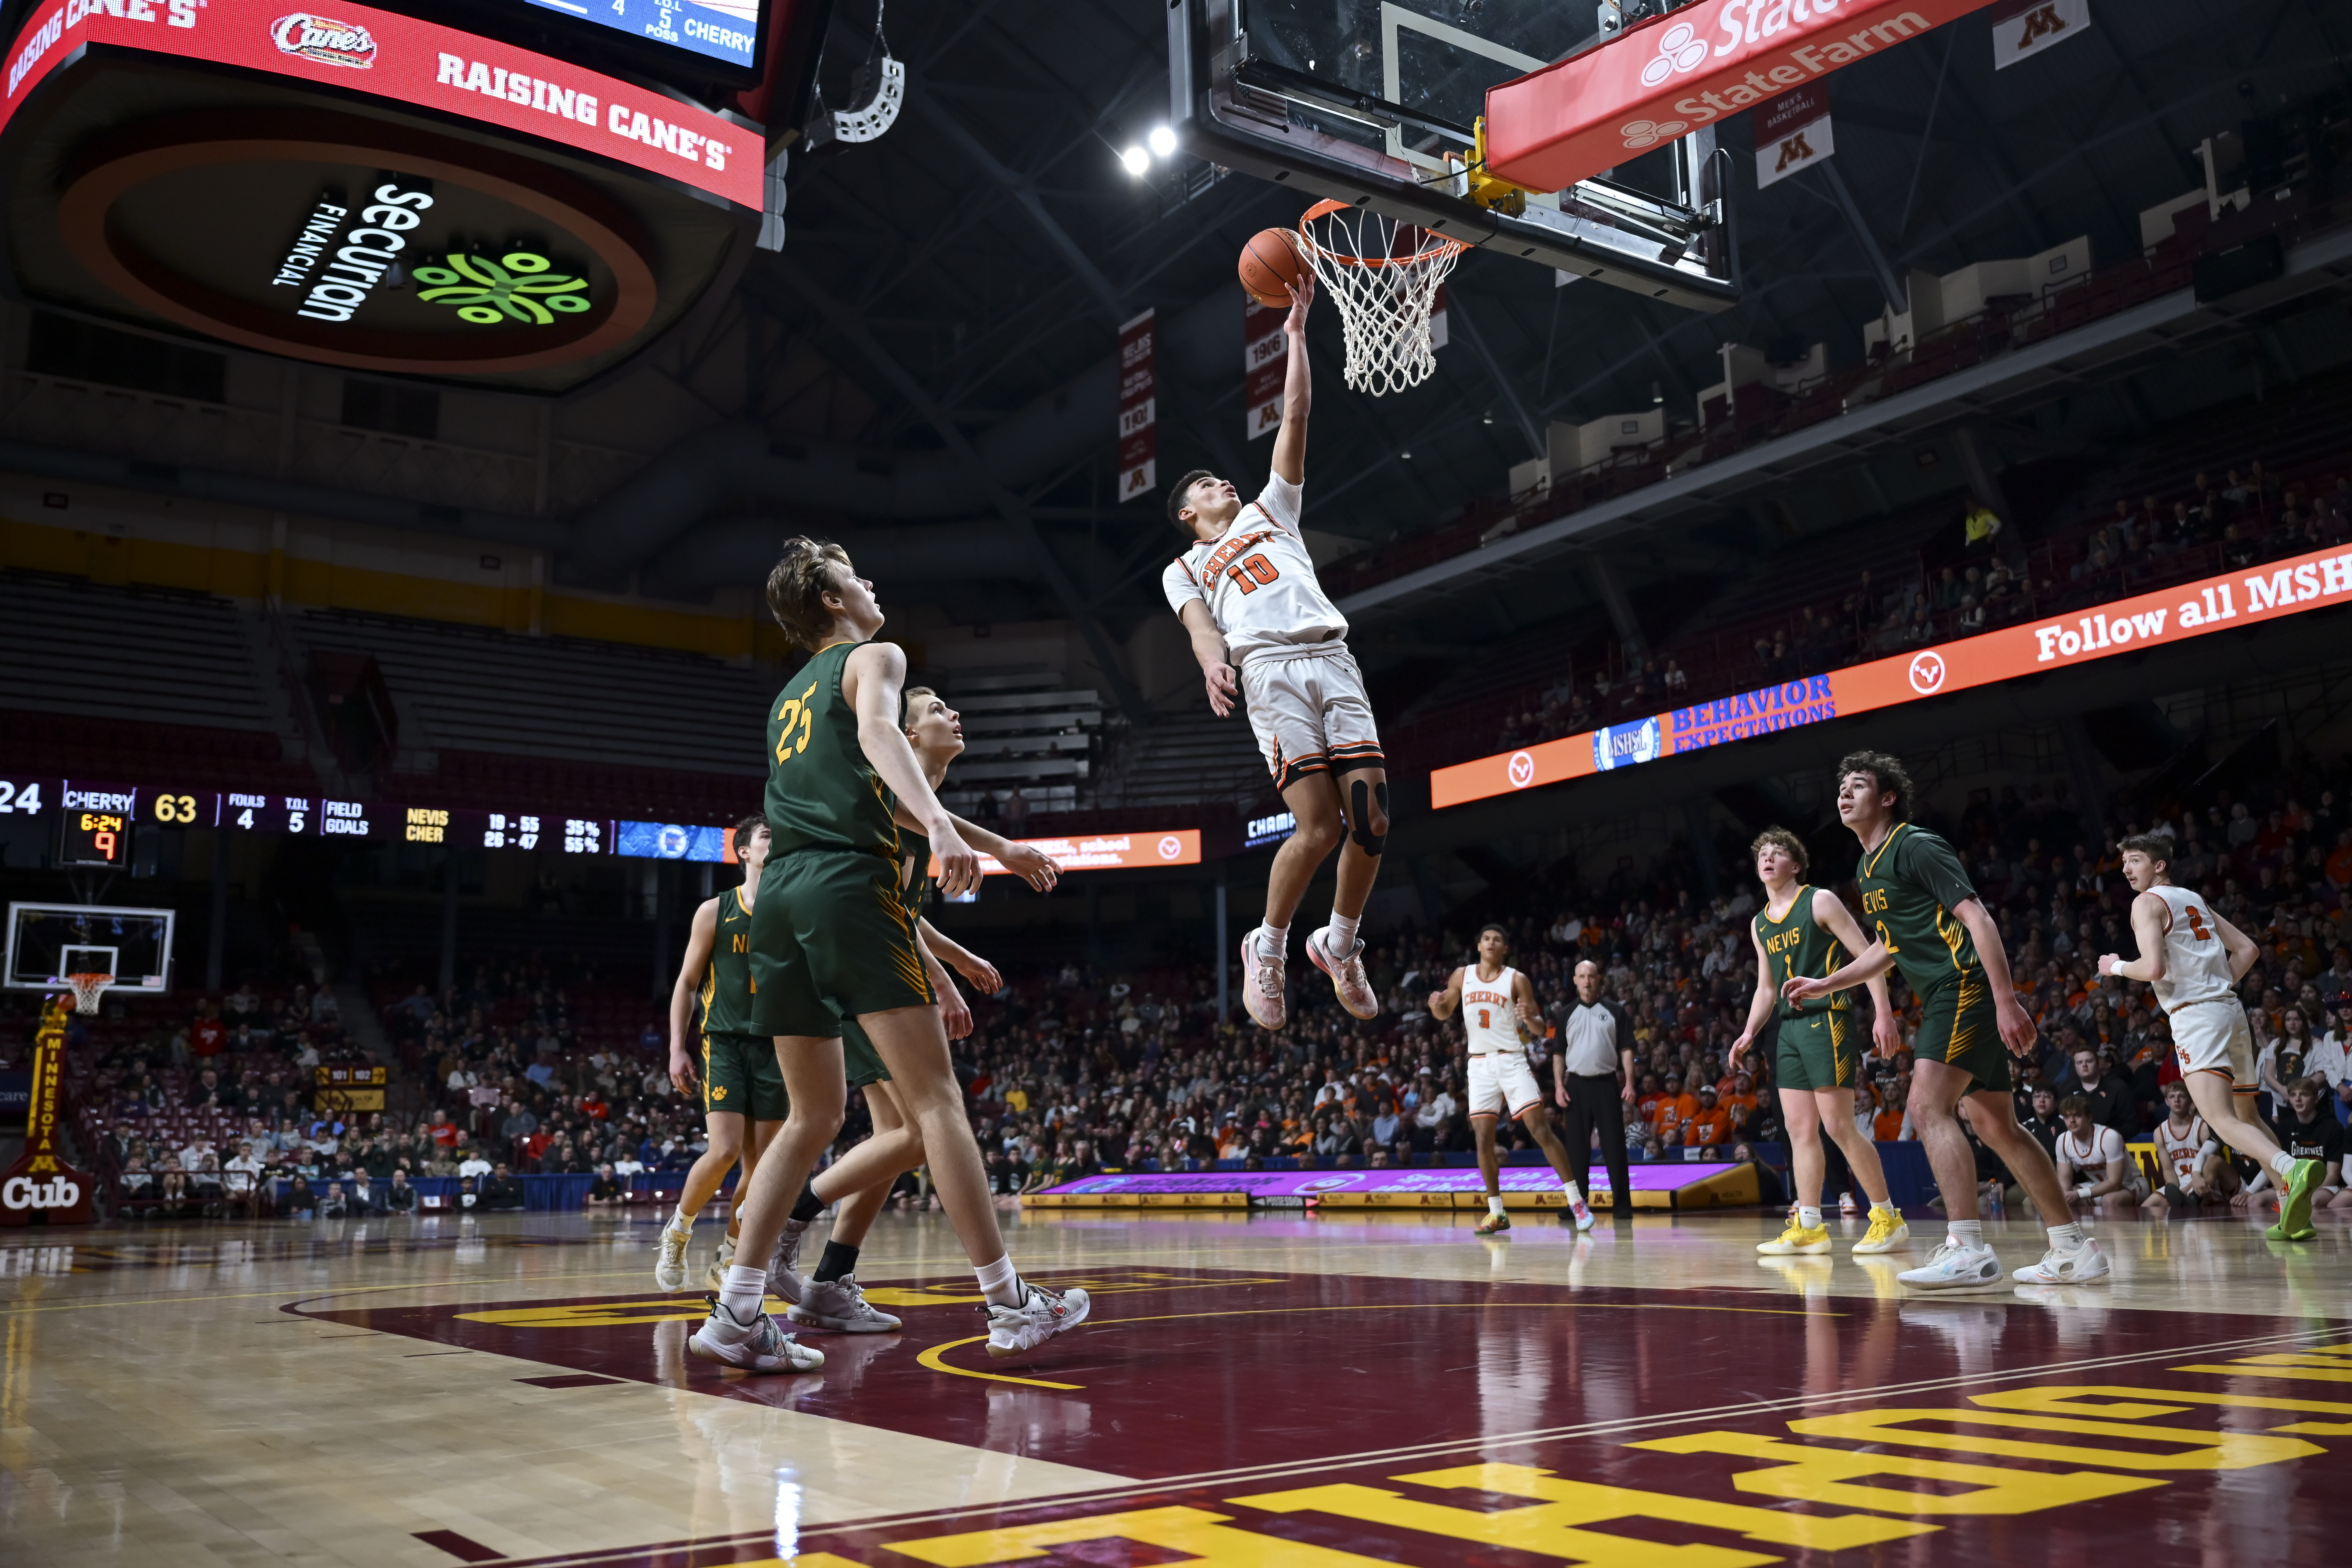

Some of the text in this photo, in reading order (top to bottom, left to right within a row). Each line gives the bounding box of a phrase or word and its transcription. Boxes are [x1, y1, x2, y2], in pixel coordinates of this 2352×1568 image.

[660, 7, 672, 29] 5
[645, 24, 679, 42] POSS
[684, 19, 755, 53] CHERRY
[7, 7, 63, 99] RAISING
[437, 52, 726, 171] RAISING CANE'S
[1767, 97, 1815, 128] BASKETBALL
[1777, 91, 1802, 112] MEN'S
[273, 203, 347, 286] FINANCIAL
[1202, 529, 1277, 592] CHERRY
[1227, 552, 1280, 596] 10
[2035, 607, 2167, 662] Follow
[2178, 583, 2236, 628] all
[1670, 673, 1832, 734] BEHAVIOR
[775, 680, 818, 767] 25
[1673, 701, 1836, 755] EXPECTATIONS
[1607, 729, 1647, 758] MSHSL
[65, 790, 135, 811] CHERRY
[155, 794, 197, 823] 63
[229, 793, 265, 808] FOULS
[327, 801, 362, 818] FIELD
[81, 814, 122, 832] 6:24
[237, 809, 253, 829] 4
[289, 812, 304, 832] 5
[326, 819, 368, 835] GOALS
[407, 808, 449, 826] NEVIS
[520, 816, 539, 833] 55
[95, 832, 115, 860] 9
[406, 825, 443, 843] CHER
[485, 831, 504, 848] 26
[519, 834, 538, 849] 47
[1080, 836, 1130, 853] school
[1876, 920, 1900, 955] 2
[2185, 906, 2211, 941] 2
[1766, 926, 1800, 955] NEVIS
[1785, 954, 1794, 980] 1
[1463, 990, 1508, 1009] CHERRY
[1478, 1009, 1490, 1029] 3
[39, 1038, 62, 1150] MINNESOTA
[3, 1176, 80, 1209] Cub
